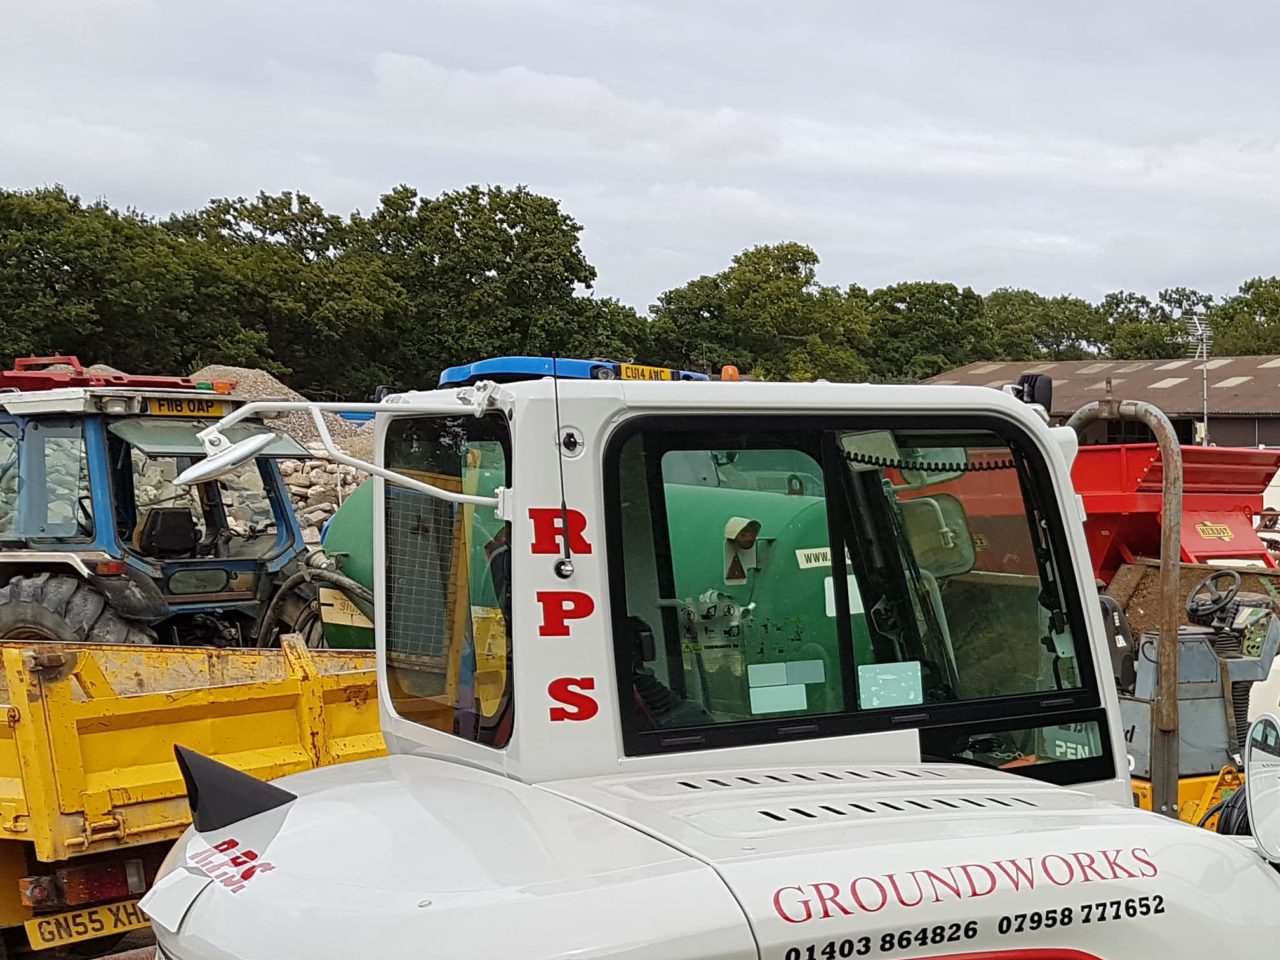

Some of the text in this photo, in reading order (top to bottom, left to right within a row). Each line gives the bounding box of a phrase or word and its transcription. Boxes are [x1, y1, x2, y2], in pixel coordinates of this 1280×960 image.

[187, 399, 214, 413] OAP
[772, 847, 1160, 923] GROUNDWORKS
[37, 910, 105, 943] GN55
[878, 920, 979, 953] 864826
[997, 907, 1074, 935] 07958
[1079, 894, 1167, 925] 777652
